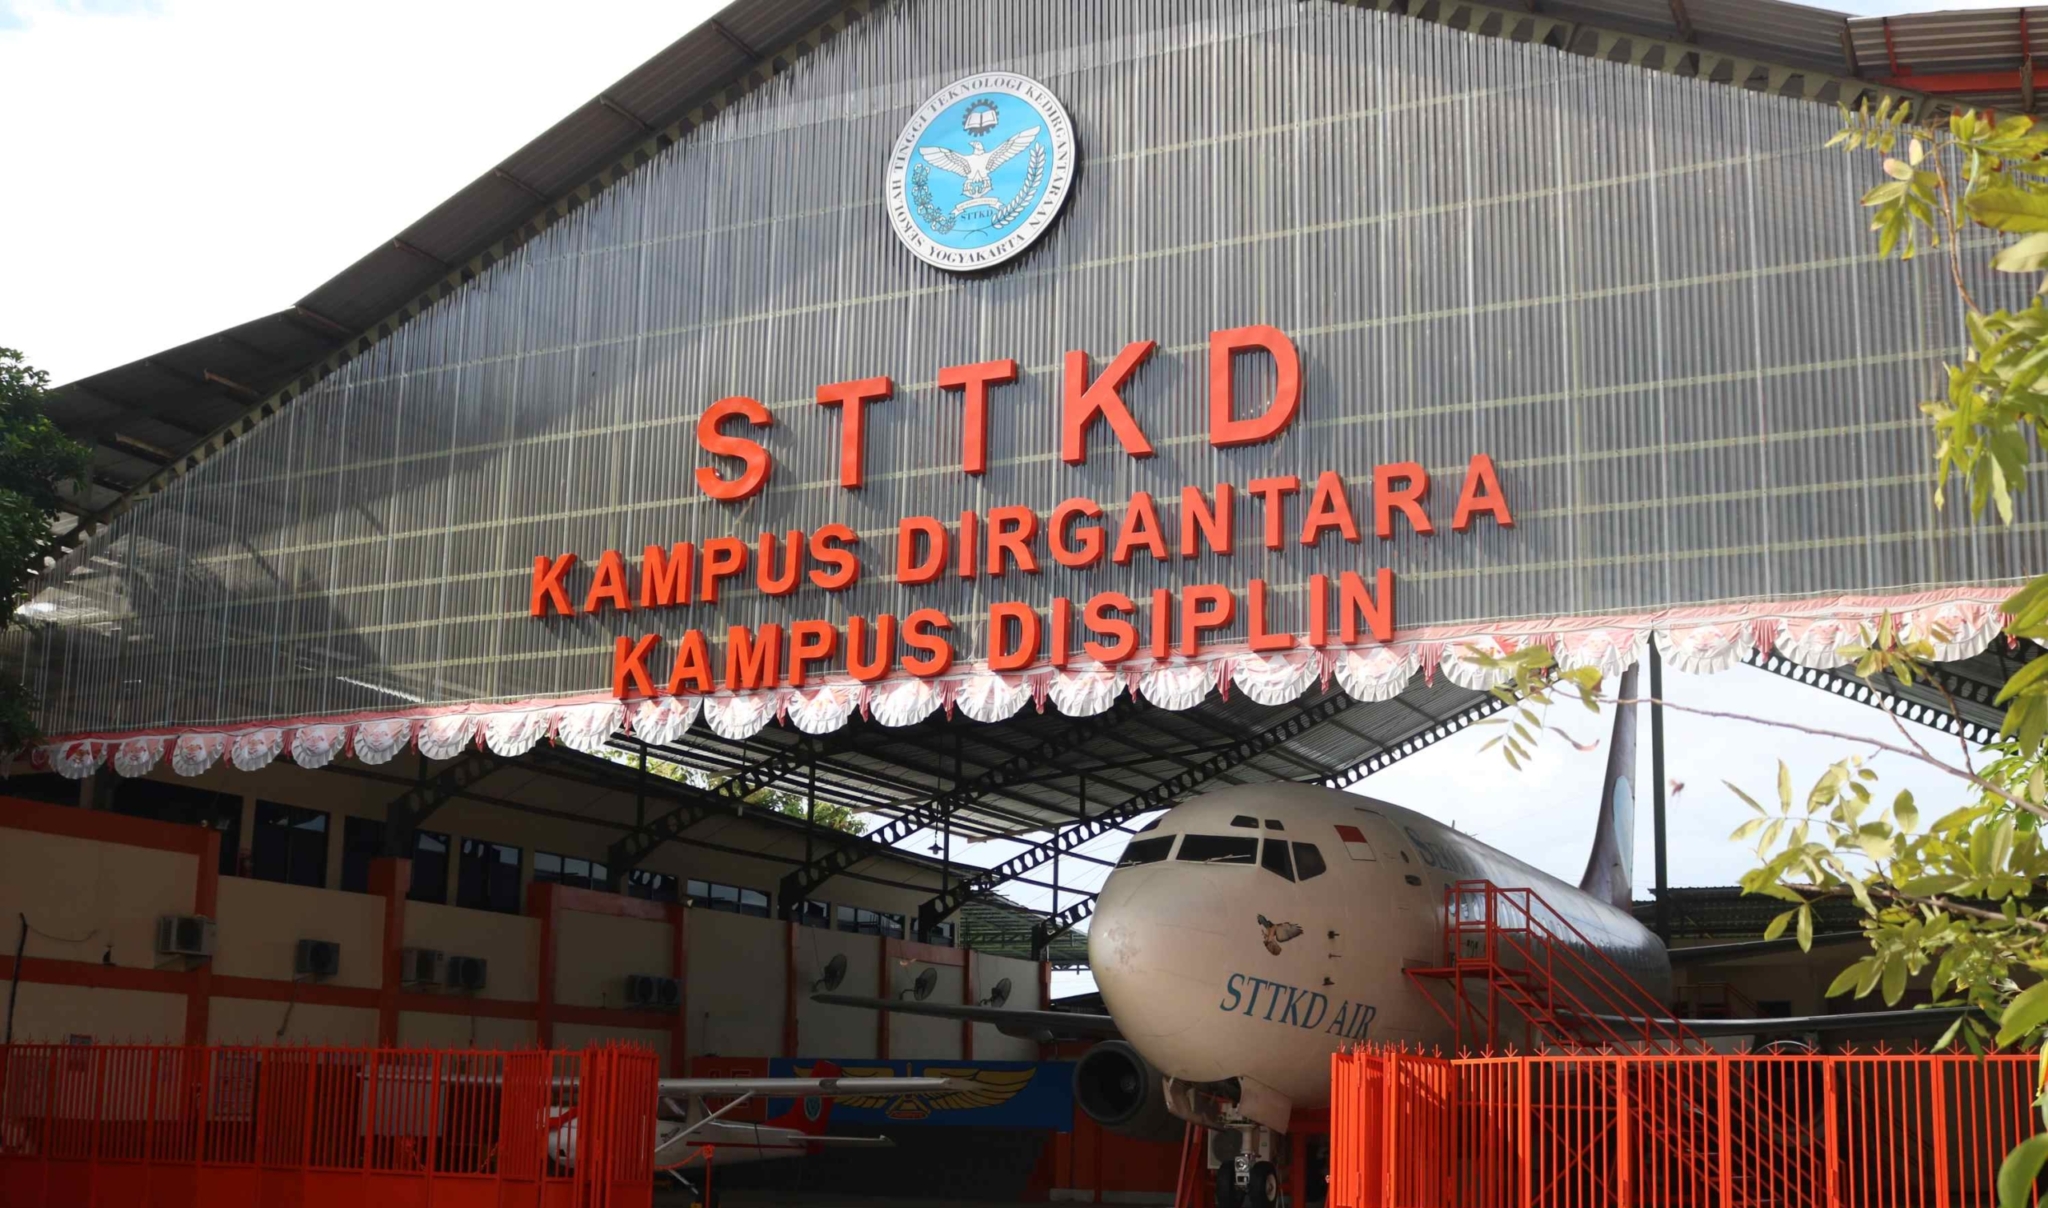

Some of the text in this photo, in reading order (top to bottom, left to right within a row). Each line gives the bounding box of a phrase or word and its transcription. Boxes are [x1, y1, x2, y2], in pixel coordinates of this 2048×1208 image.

[929, 77, 1021, 113] TEKNOLOGI
[894, 115, 927, 171] TINGGI
[1026, 86, 1069, 229] KEDIRGANTARAAN
[892, 179, 925, 248] SEKOLAH
[961, 209, 993, 221] STTKD
[929, 234, 1025, 264] YOGYAKARTA
[696, 324, 1303, 501] STTKD
[531, 453, 1514, 616] KAMPUS DIRGANTARA
[613, 567, 1395, 698] KAMPUS DISIPLIN
[1220, 973, 1377, 1039] STTKD AIR
